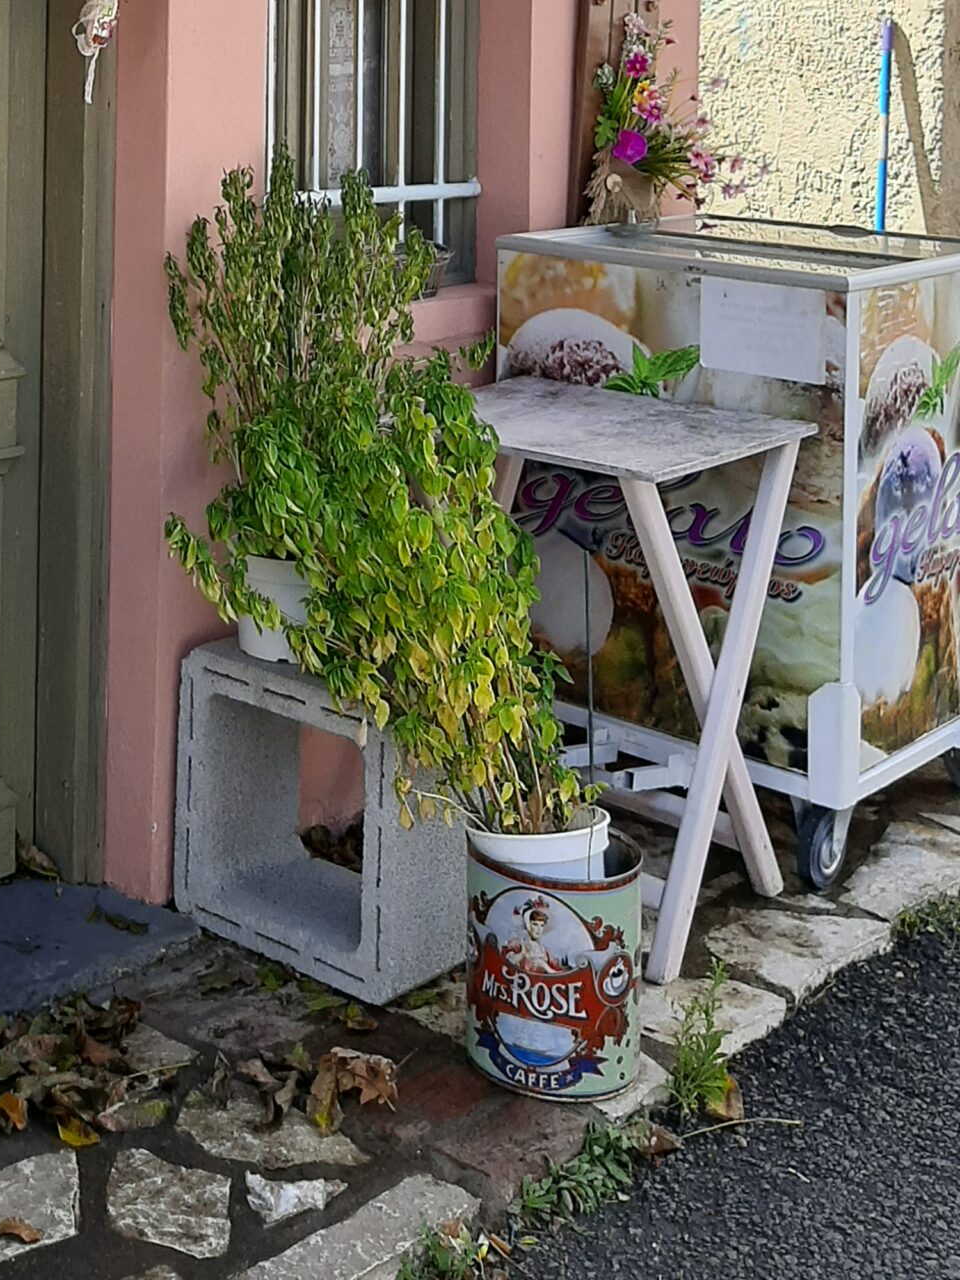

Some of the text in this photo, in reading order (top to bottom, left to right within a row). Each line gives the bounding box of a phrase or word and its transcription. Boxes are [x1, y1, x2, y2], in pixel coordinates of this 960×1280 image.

[514, 470, 826, 565] geao
[482, 965, 588, 1020] Mrs. ROSE
